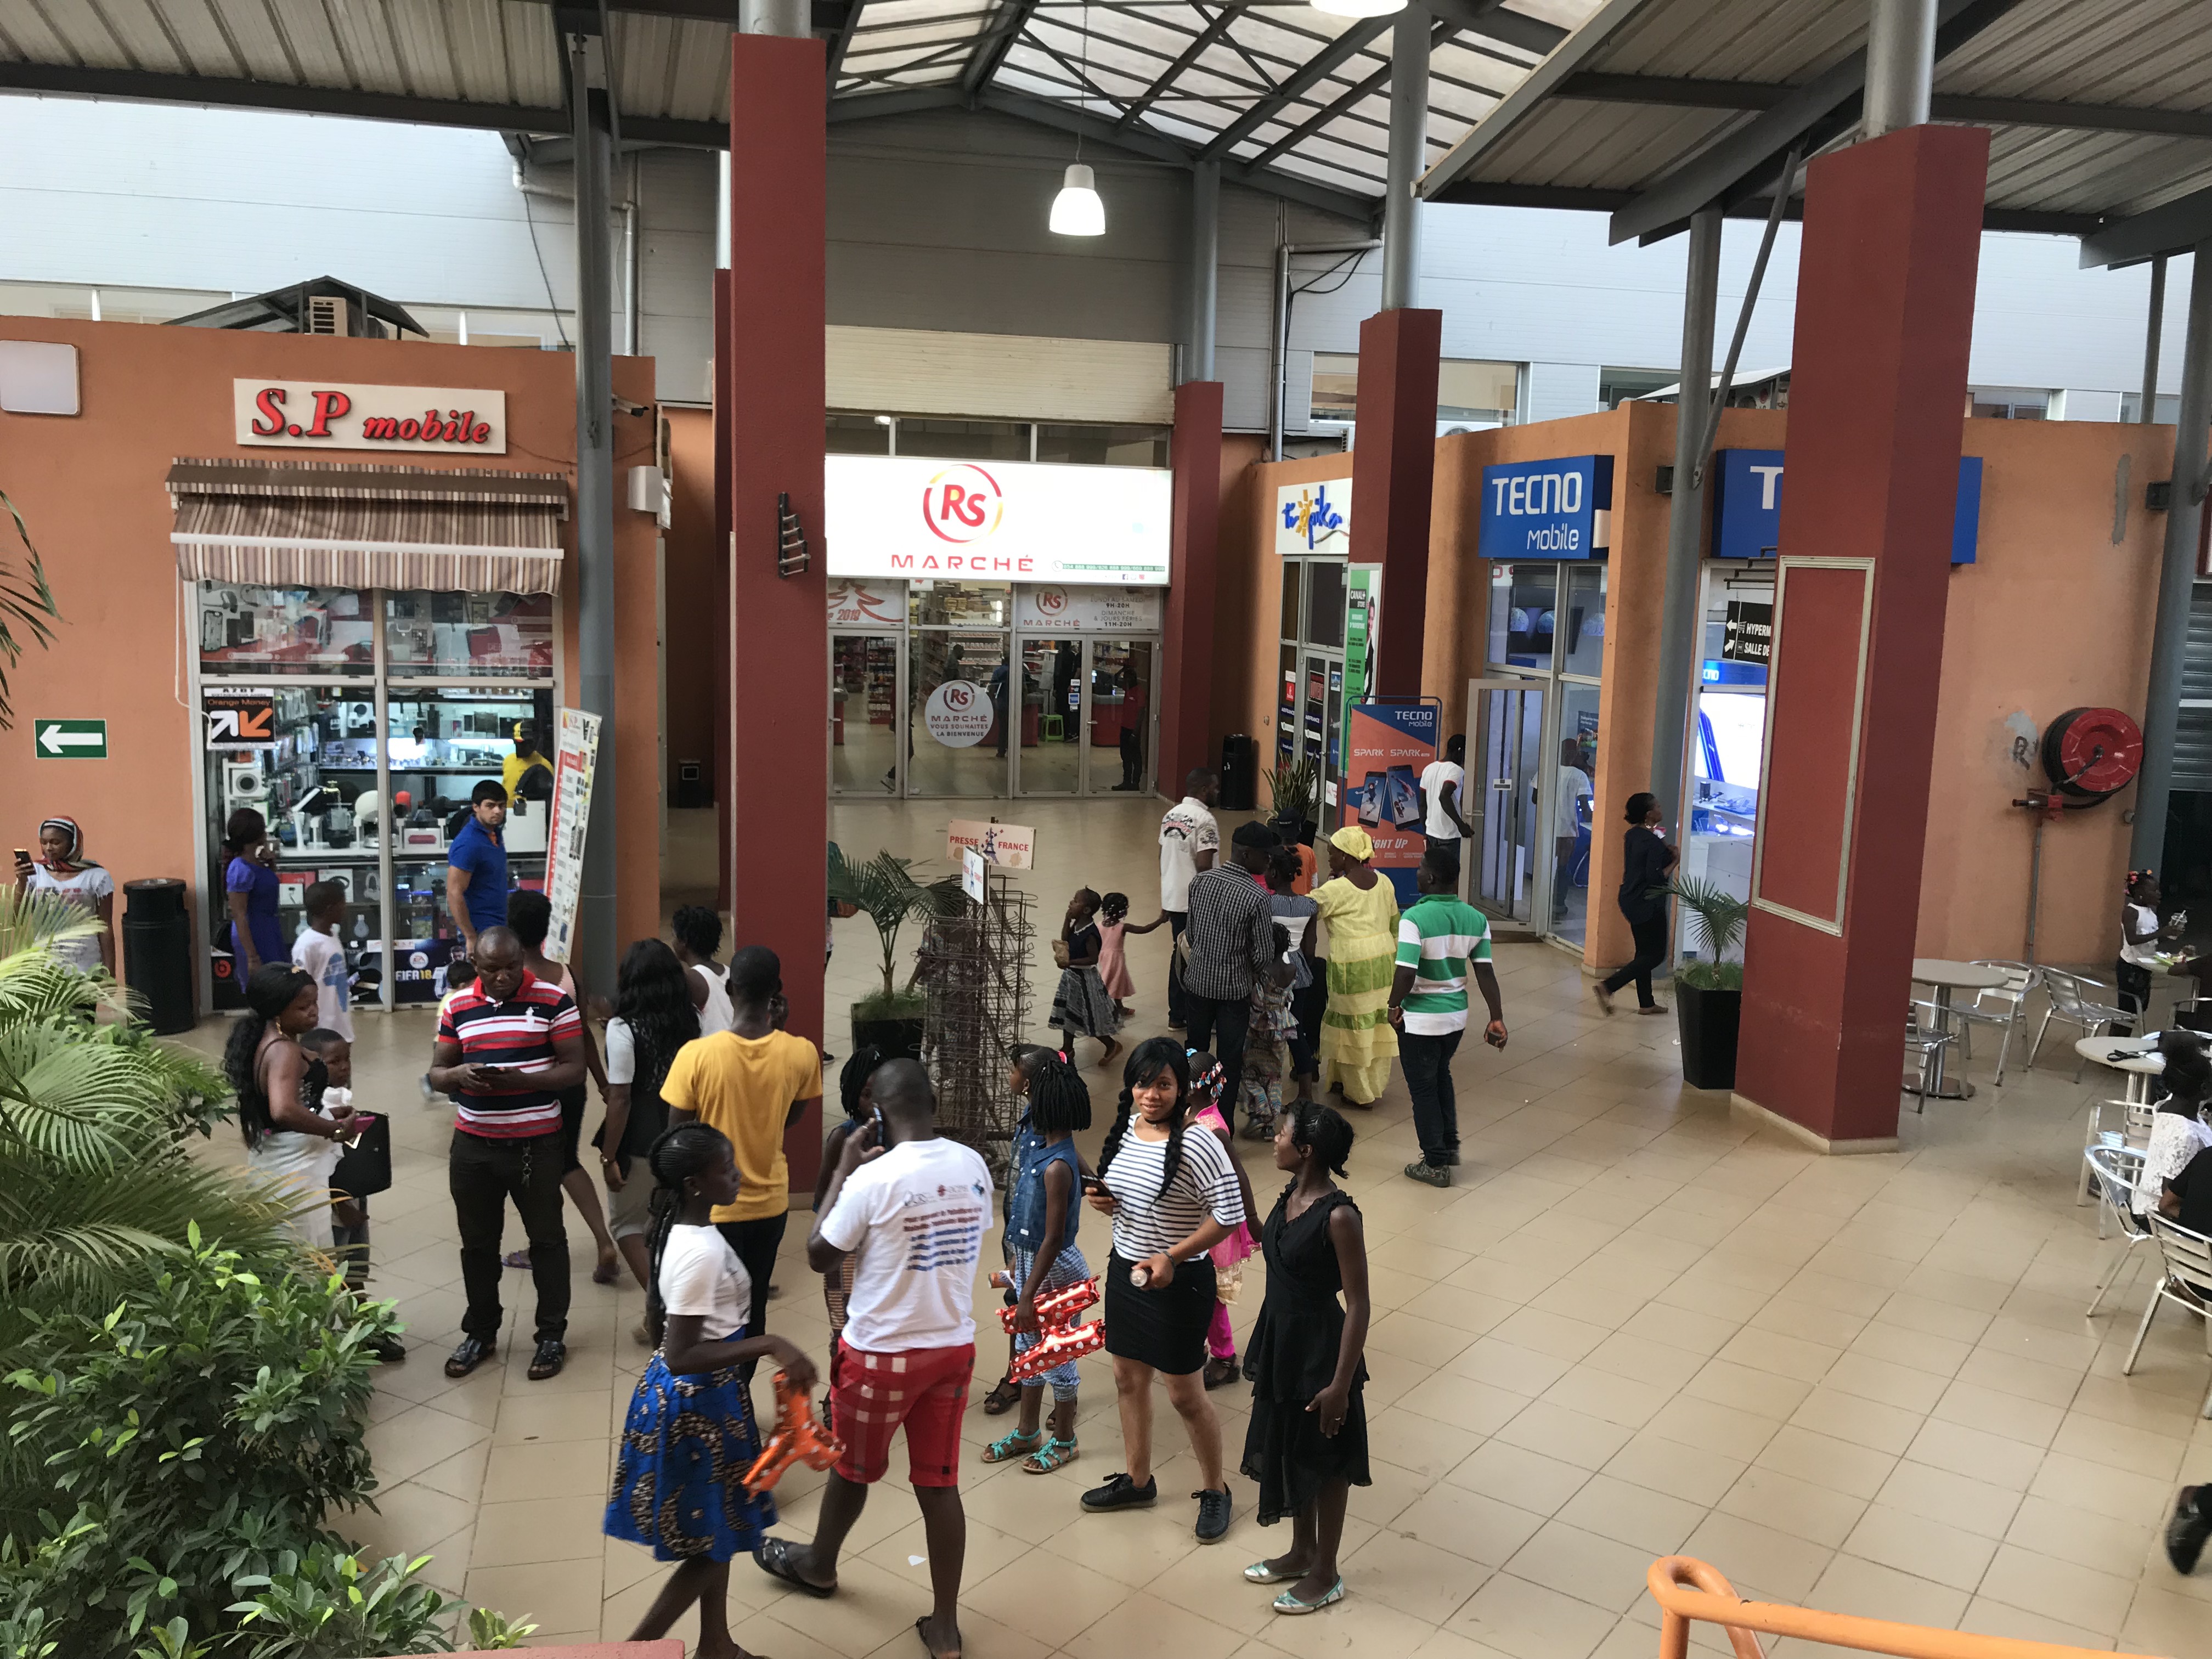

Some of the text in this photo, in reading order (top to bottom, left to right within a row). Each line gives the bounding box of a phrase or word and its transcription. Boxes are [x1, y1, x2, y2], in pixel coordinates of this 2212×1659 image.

[252, 388, 490, 443] S.P mobile
[1492, 471, 1582, 516] TECNO
[891, 555, 1033, 572] MARCHÉ
[1350, 590, 1365, 600] CANAL+
[1744, 642, 1762, 656] SALLE
[1395, 711, 1432, 720] TECNO
[1354, 749, 1384, 757] SPARK
[1390, 749, 1421, 757] SPARK
[950, 836, 1029, 851] PRESSE FRANCE
[1395, 837, 1408, 849] UP
[395, 969, 419, 981] FIFA
